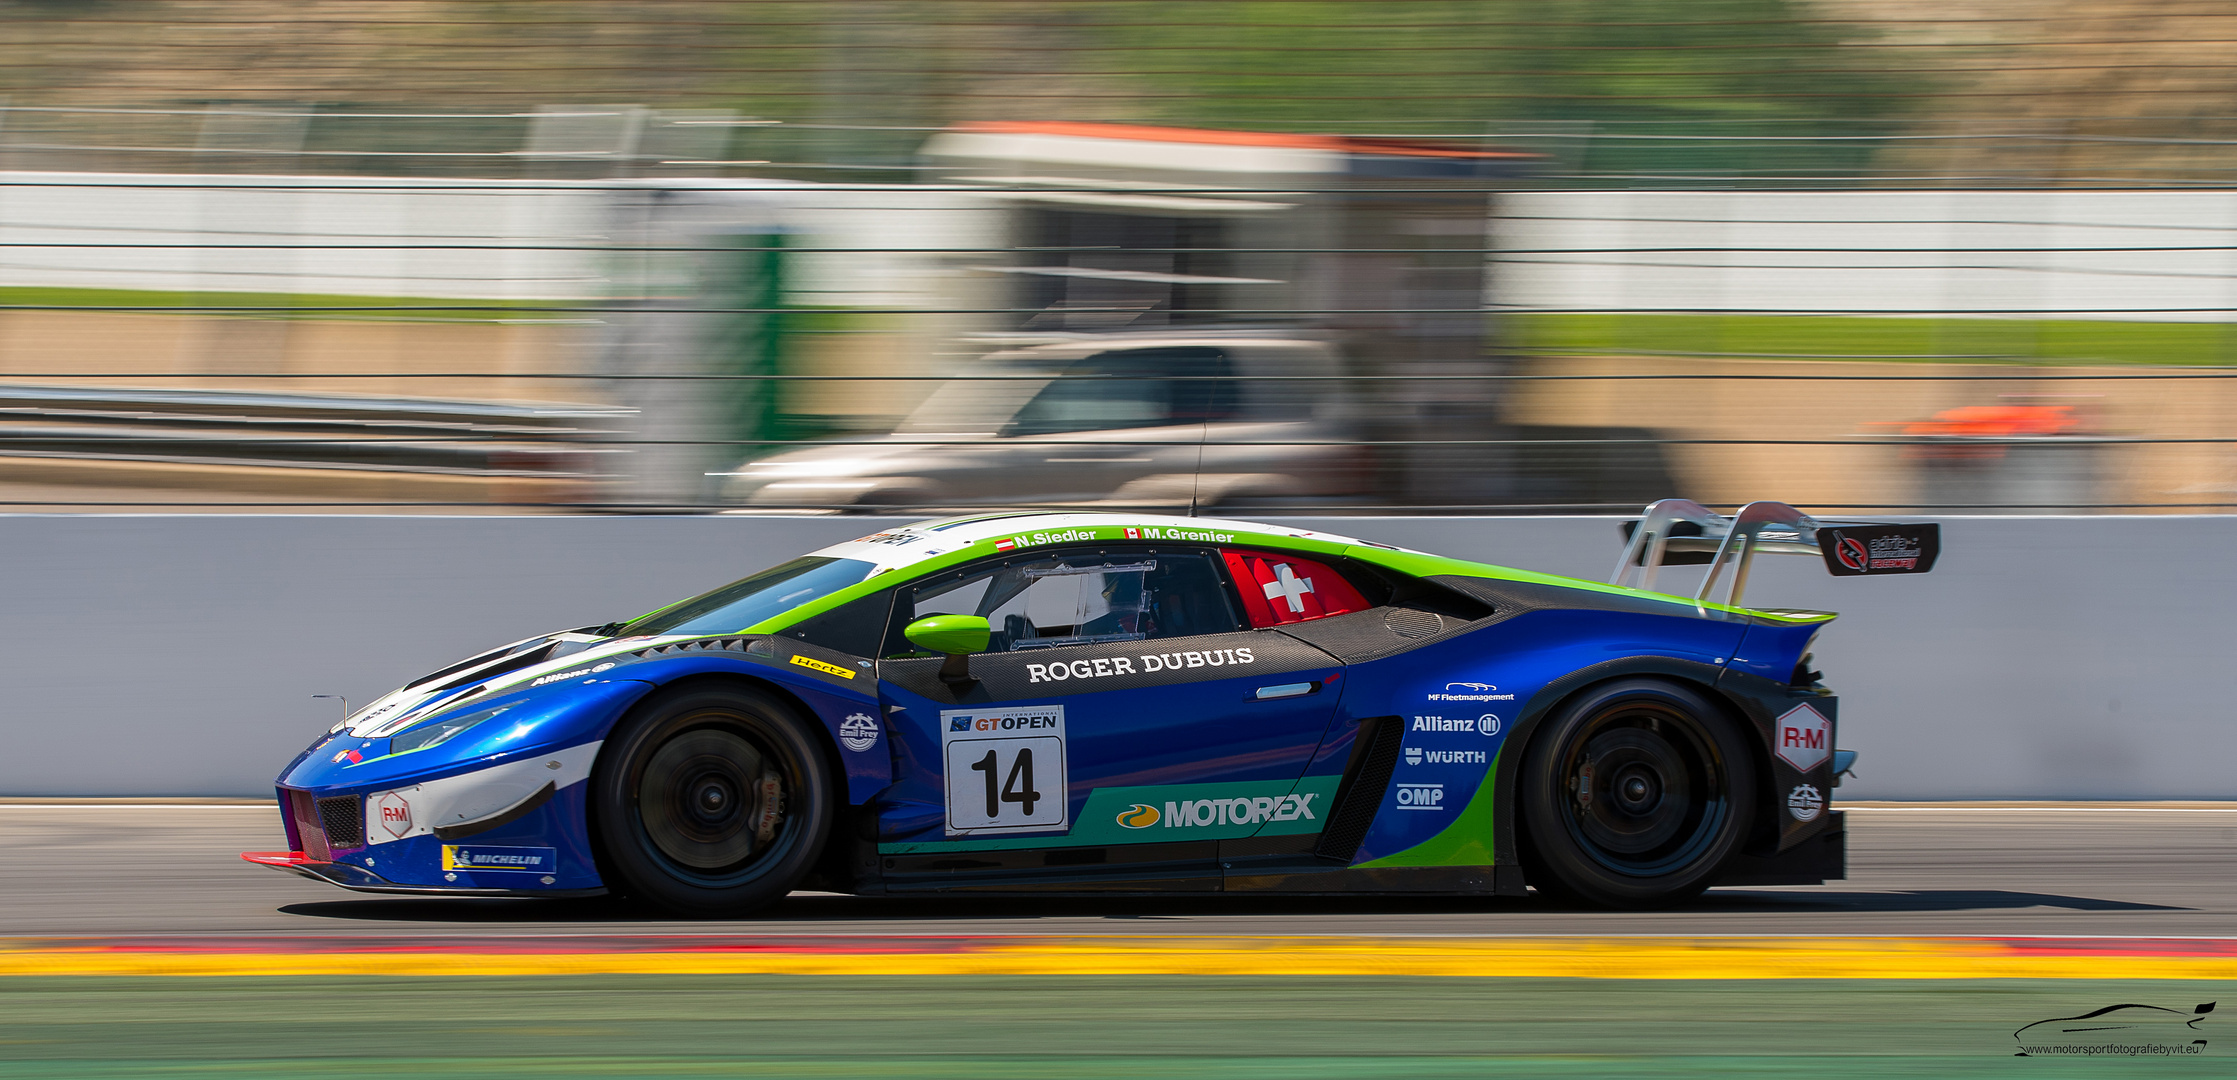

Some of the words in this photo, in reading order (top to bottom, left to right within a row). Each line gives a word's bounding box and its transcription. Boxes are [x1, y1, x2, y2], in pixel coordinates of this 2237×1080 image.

[1014, 530, 1097, 548] N.Siedler
[1143, 528, 1235, 543] M.Grenier
[797, 658, 847, 676] Hertz
[1027, 657, 1136, 683] ROGER
[1140, 647, 1255, 673] DUBUIS
[530, 668, 592, 687] Allianz
[1441, 693, 1515, 703] Fleetmanagement
[975, 716, 1057, 731] GTOPEN
[1412, 716, 1475, 732] Allianz
[840, 729, 859, 737] Emil
[860, 730, 879, 739] Frey
[1783, 727, 1825, 750] R-M
[1425, 751, 1486, 763] WÜRTH
[971, 748, 1041, 818] 14
[1397, 788, 1444, 806] OMP
[383, 806, 408, 822] R-M
[1164, 793, 1316, 828] MOTOREX
[472, 854, 543, 865] MICHELIN
